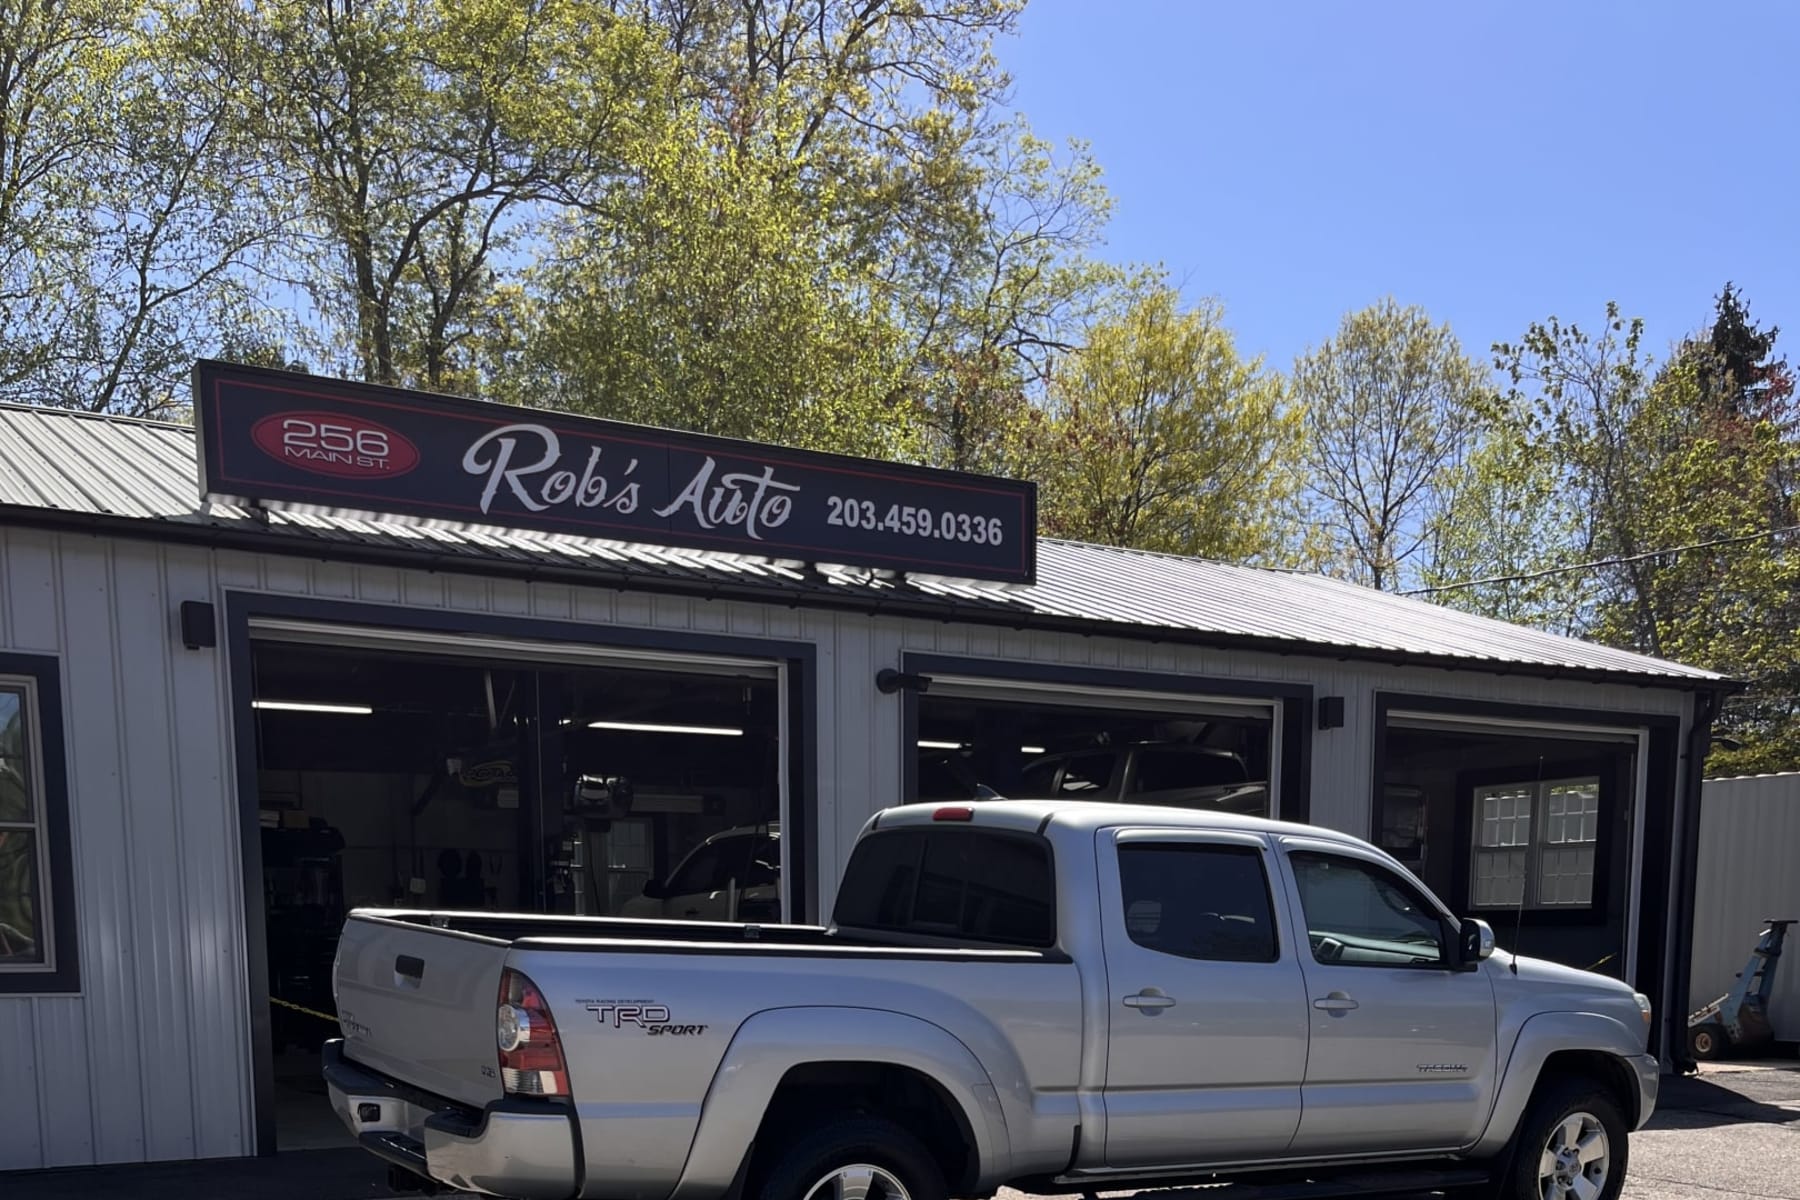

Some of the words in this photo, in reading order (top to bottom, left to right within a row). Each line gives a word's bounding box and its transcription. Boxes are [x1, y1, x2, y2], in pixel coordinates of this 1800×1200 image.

[283, 419, 389, 457] 256
[284, 446, 353, 465] MAIN
[356, 456, 390, 470] ST.
[462, 423, 641, 515] Rob's
[652, 455, 801, 540] Auto
[826, 495, 1003, 546] 203.459.0336
[586, 1005, 670, 1028] TRD
[646, 1024, 709, 1036] SPORT
